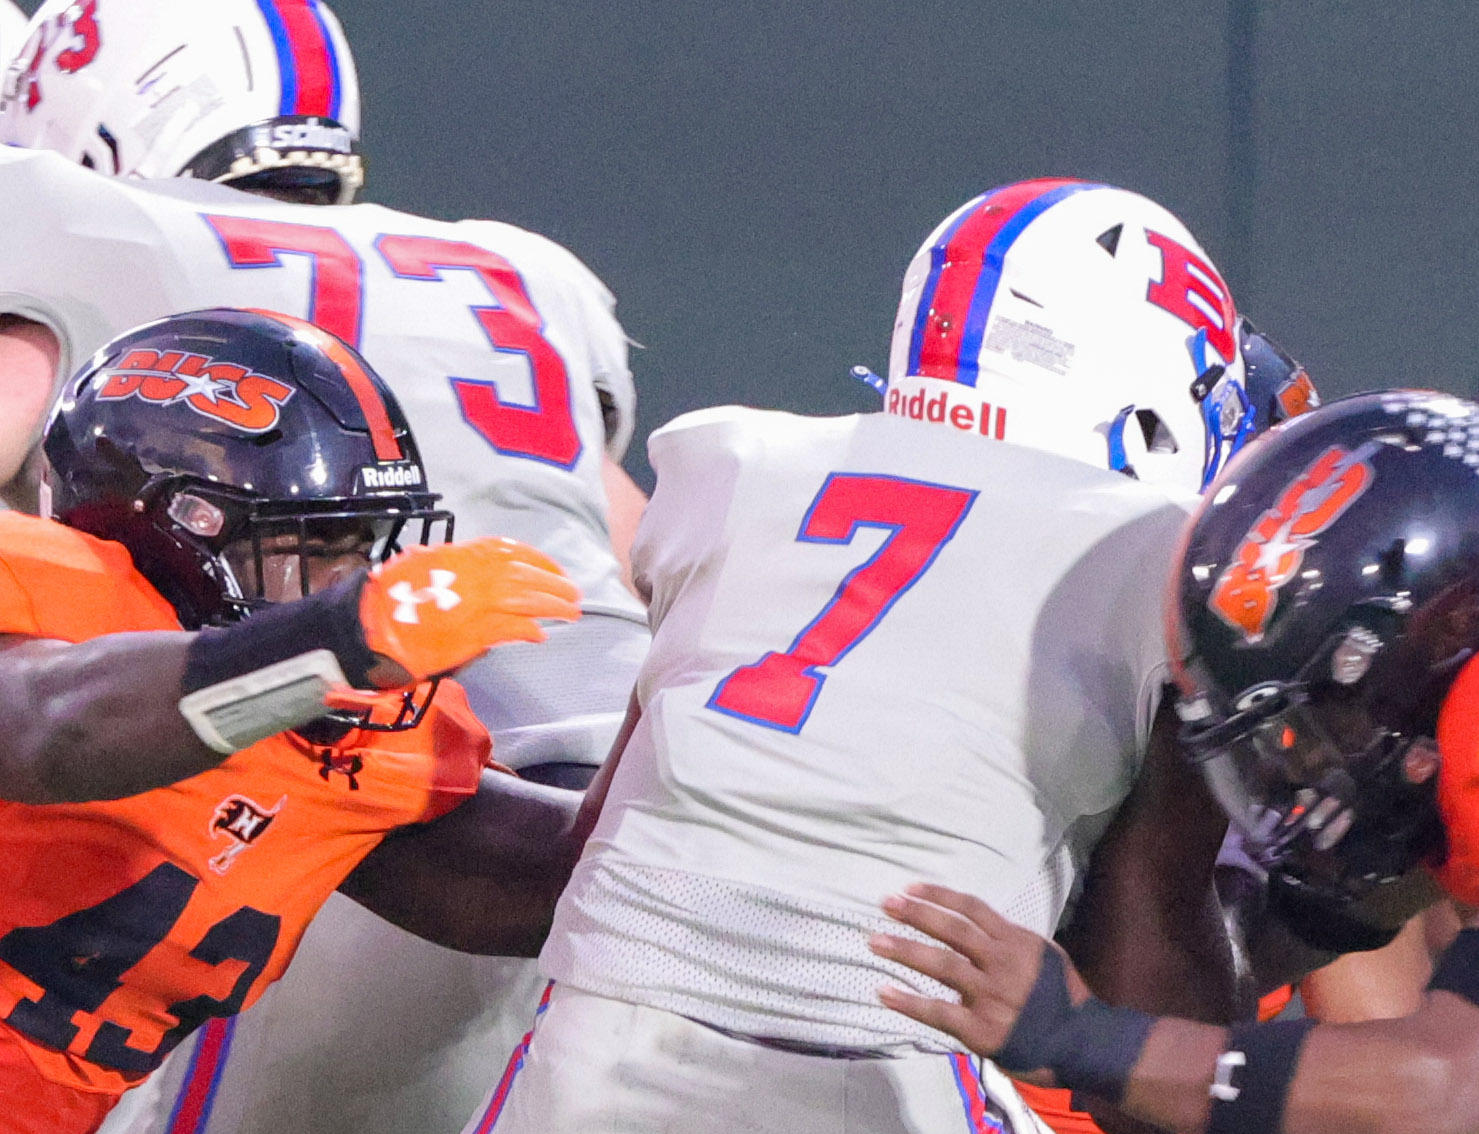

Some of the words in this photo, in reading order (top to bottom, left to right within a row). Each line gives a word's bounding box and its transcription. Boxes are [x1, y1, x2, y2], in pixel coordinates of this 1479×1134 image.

[197, 212, 584, 472] 73
[95, 348, 296, 433] BUCS
[889, 388, 1007, 441] Riddell
[361, 464, 421, 487] Riddell
[705, 472, 981, 735] 7
